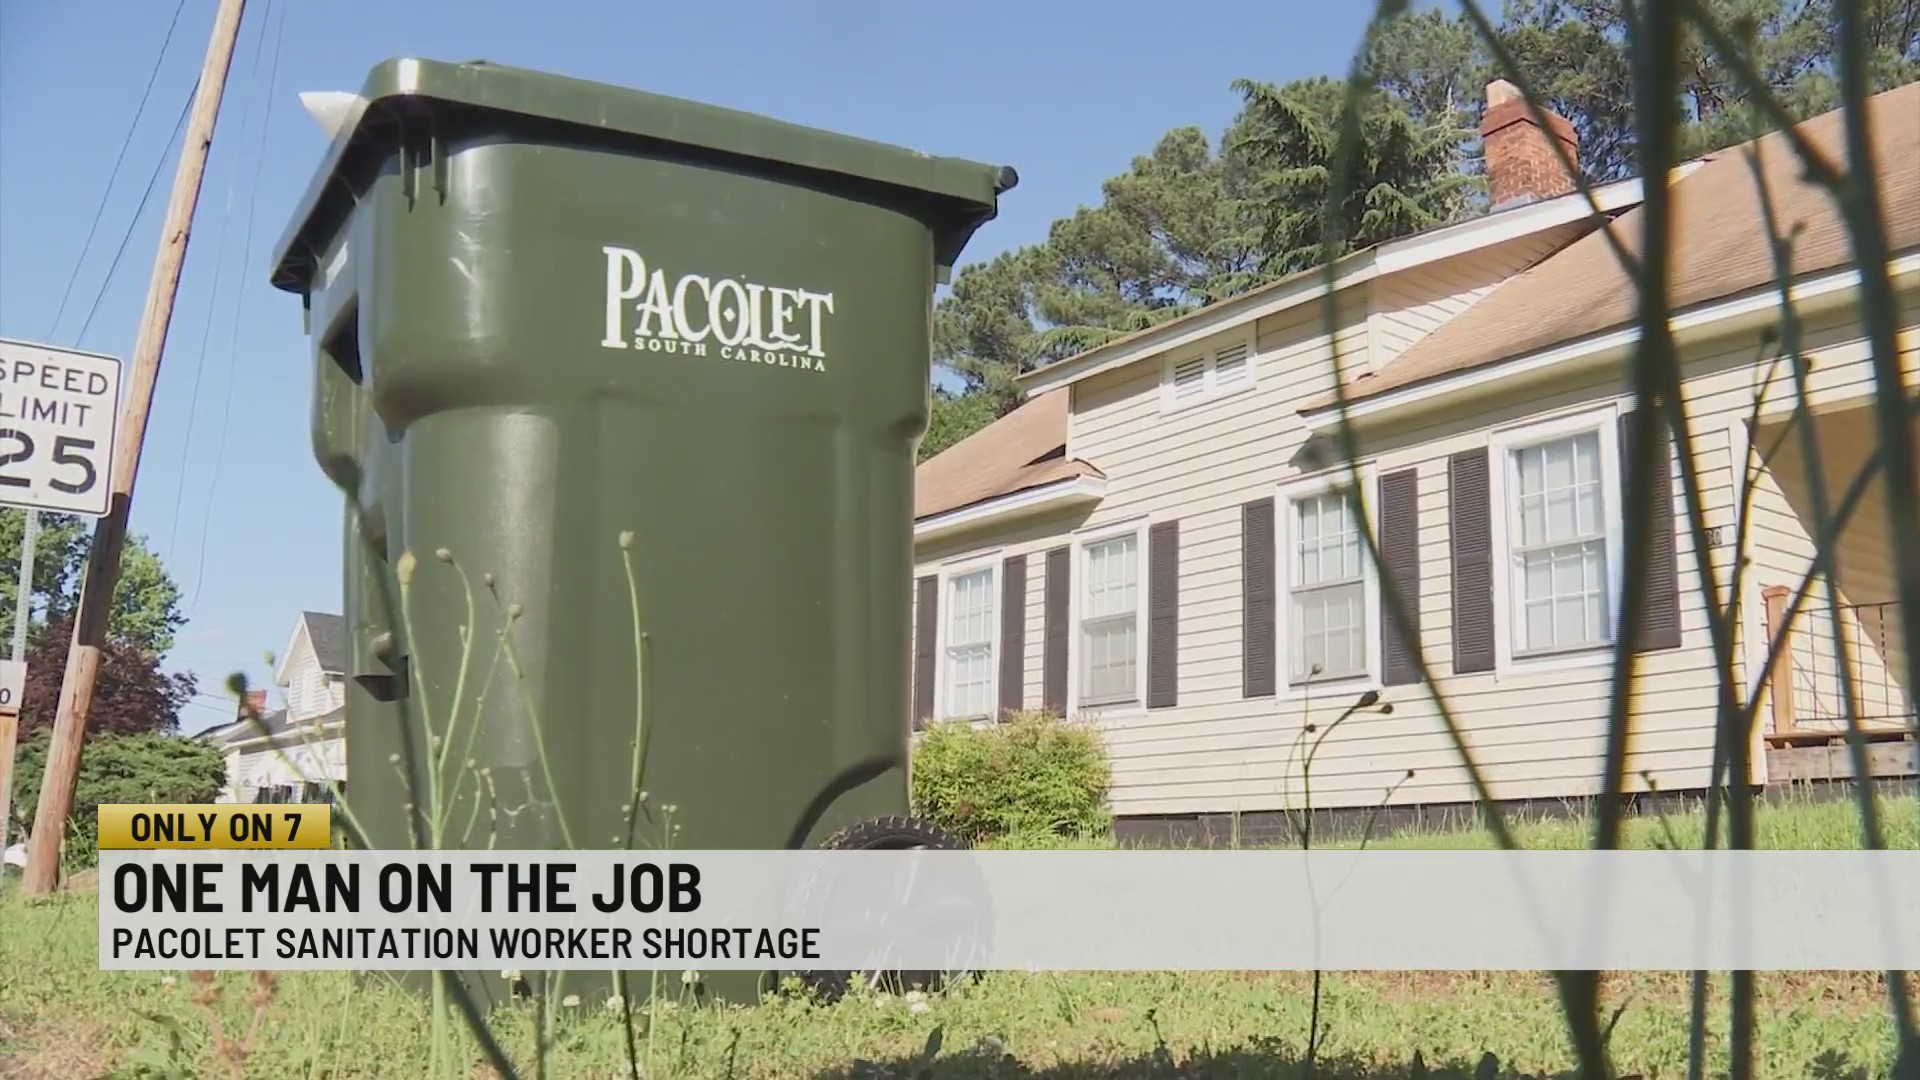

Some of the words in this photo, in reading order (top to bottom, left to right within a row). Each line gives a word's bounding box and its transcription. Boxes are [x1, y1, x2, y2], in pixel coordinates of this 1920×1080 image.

[601, 246, 834, 357] PACOLET
[634, 337, 707, 356] SOUTH
[720, 346, 826, 372] CAROLINA
[0, 428, 97, 495] 25
